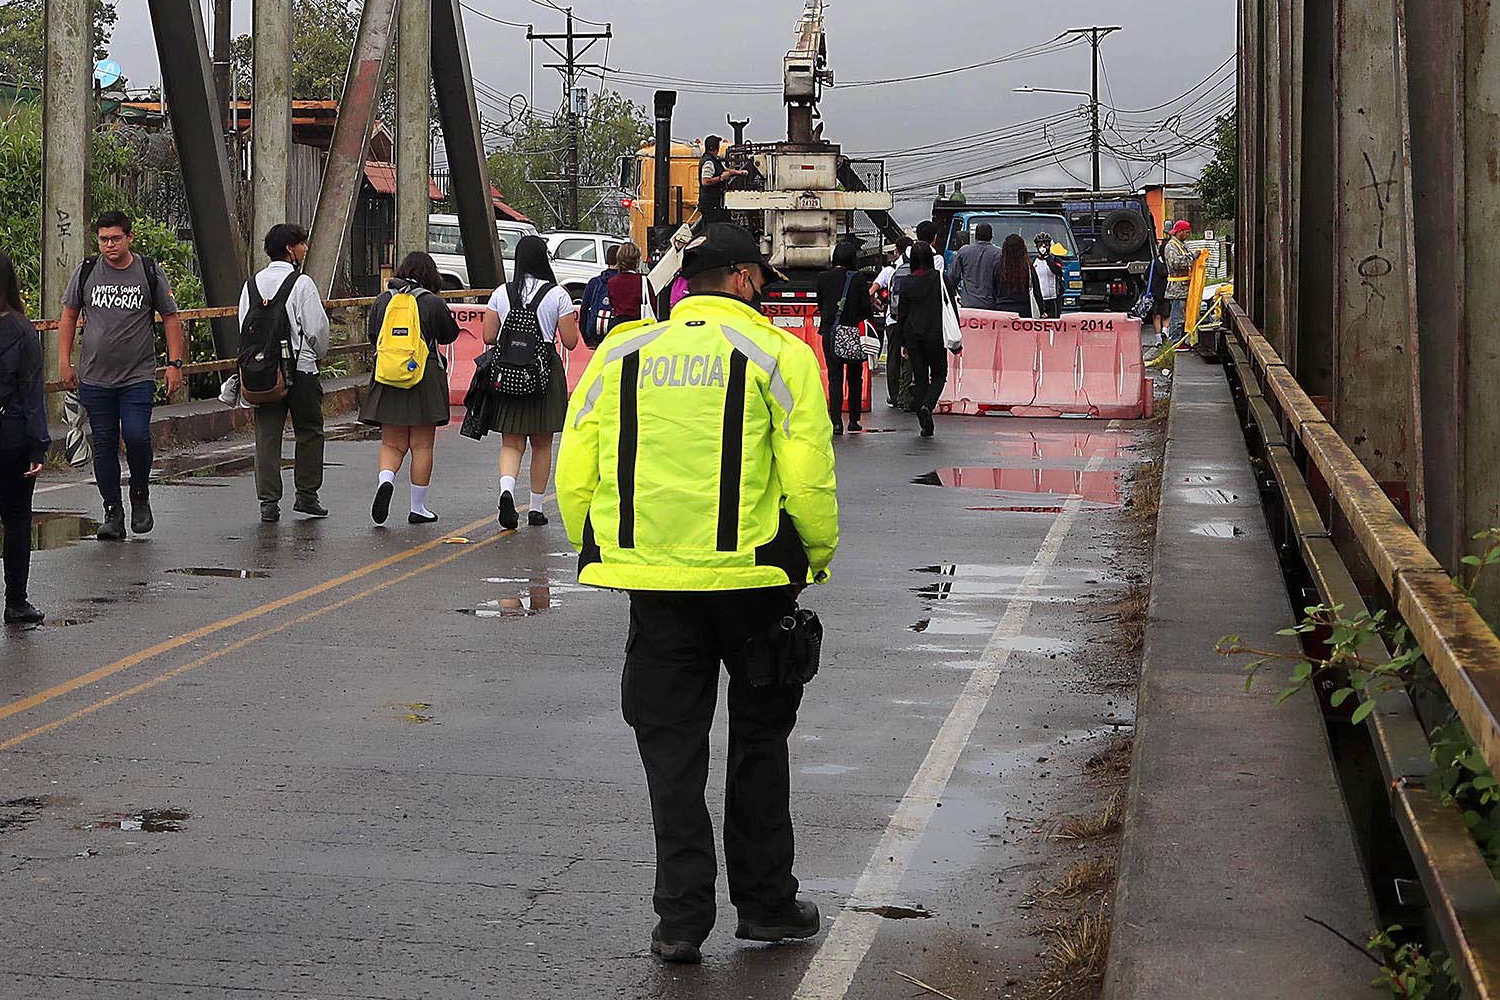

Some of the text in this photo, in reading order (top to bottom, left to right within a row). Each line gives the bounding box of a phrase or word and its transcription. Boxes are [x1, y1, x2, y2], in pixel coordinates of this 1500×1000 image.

[120, 284, 141, 295] SOMOS
[1011, 319, 1068, 333] COSEVI
[1080, 319, 1114, 331] 2014
[639, 354, 725, 389] POLICIA
